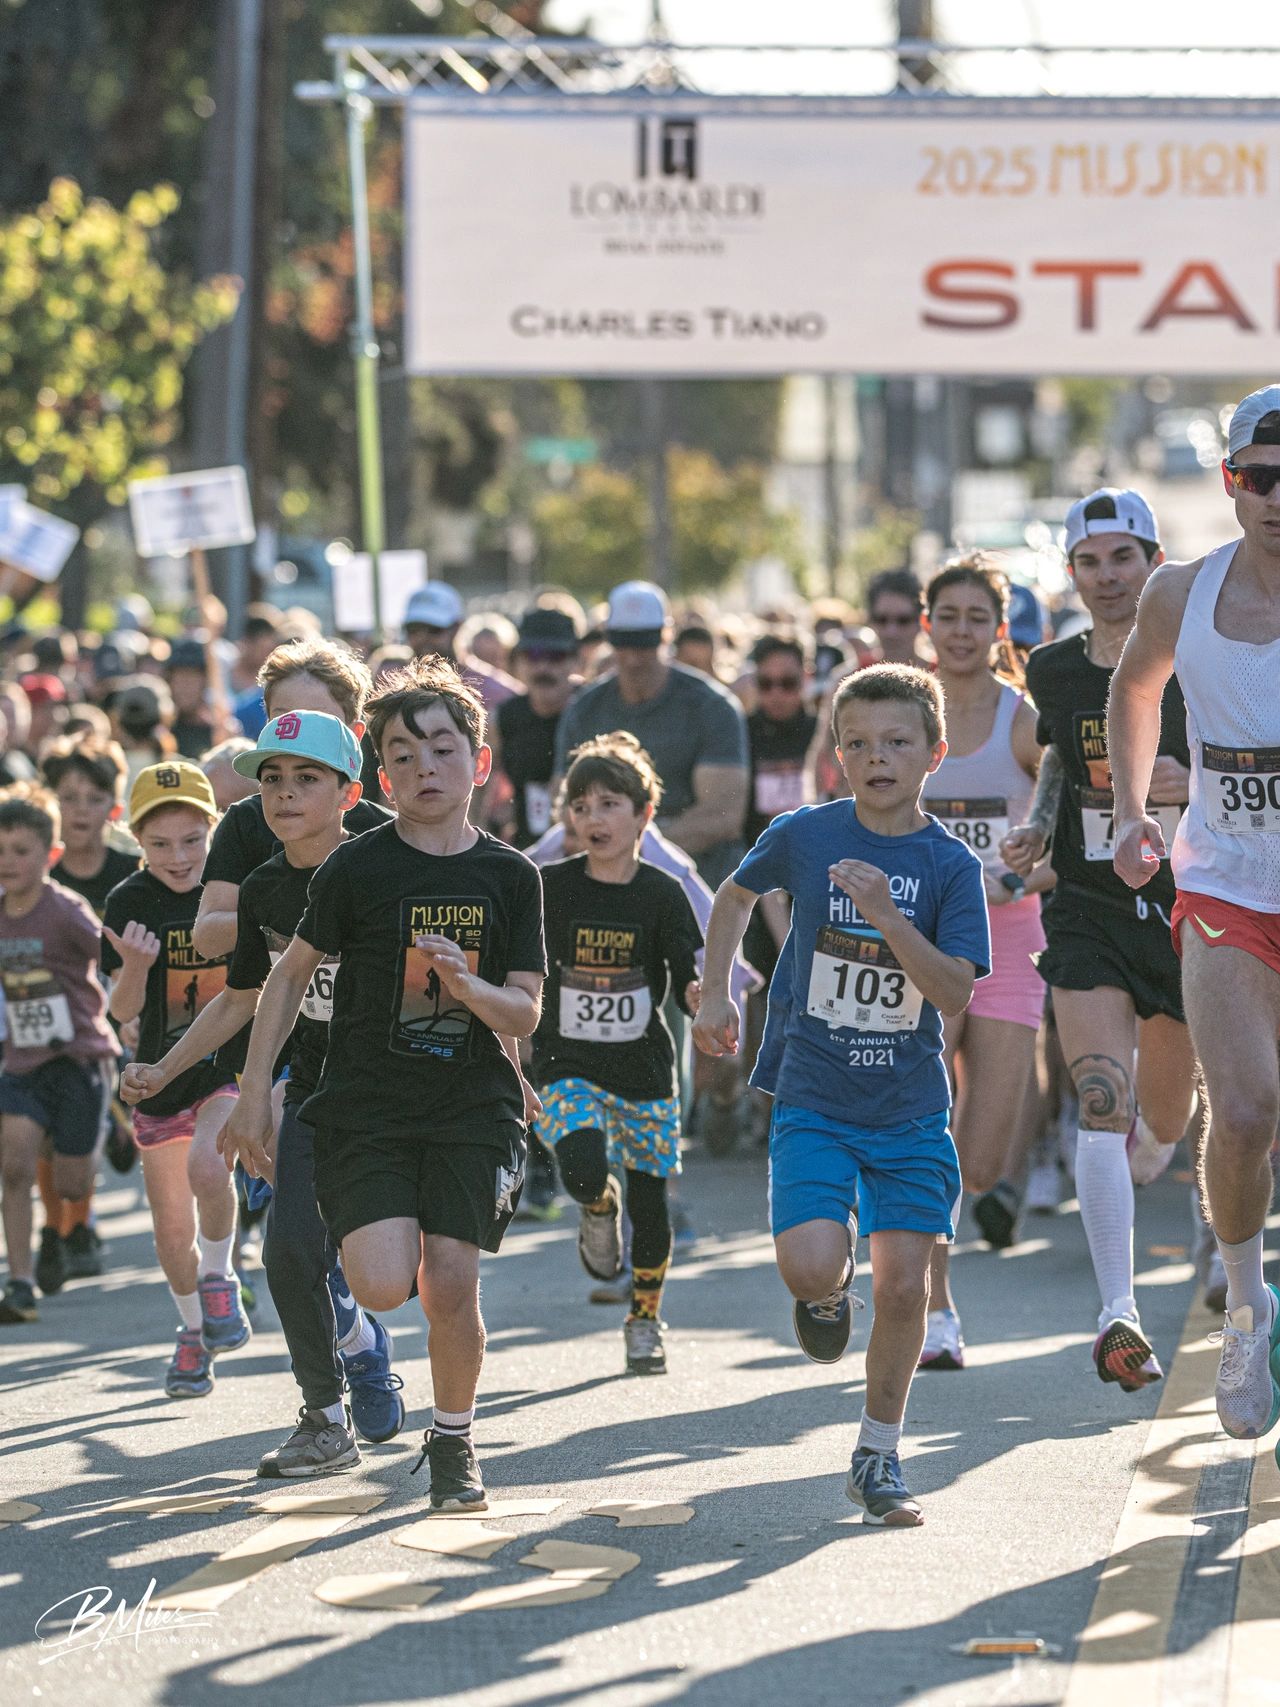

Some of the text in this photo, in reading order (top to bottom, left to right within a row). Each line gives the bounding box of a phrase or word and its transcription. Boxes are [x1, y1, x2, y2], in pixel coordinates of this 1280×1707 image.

[917, 146, 1036, 197] 2025
[1048, 142, 1268, 197] MISSION
[569, 182, 766, 219] LOMBARDI
[943, 822, 990, 849] 88
[410, 905, 484, 926] MISSION
[577, 928, 636, 949] MISSION
[576, 947, 615, 964] HILLS
[833, 963, 906, 1010] 103
[577, 994, 634, 1024] 320
[849, 1038, 896, 1046] ANNUAL
[849, 1048, 894, 1067] 2021
